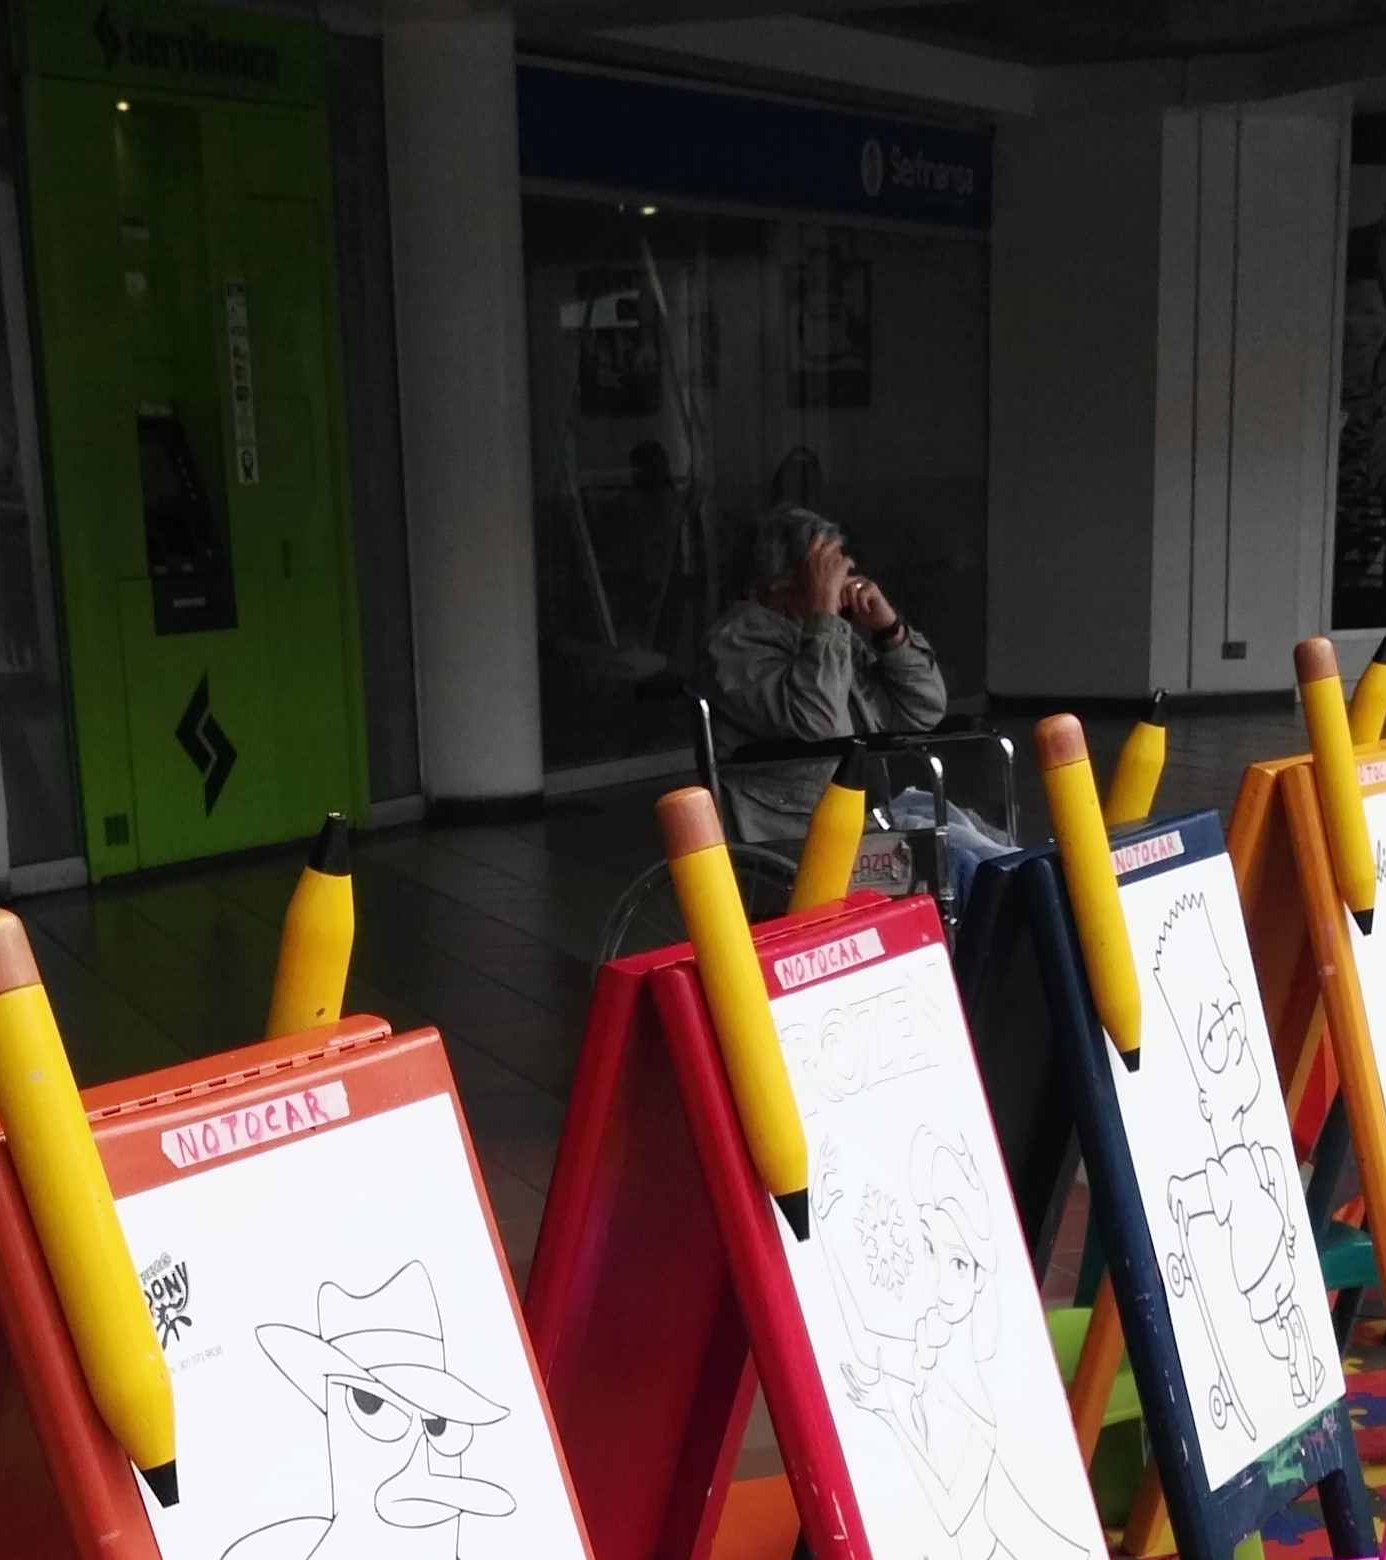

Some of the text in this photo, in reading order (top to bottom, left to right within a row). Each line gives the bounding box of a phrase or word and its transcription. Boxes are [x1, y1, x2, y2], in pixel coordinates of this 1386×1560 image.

[853, 853, 892, 874] AZA
[781, 938, 862, 987] NOTOCAR
[779, 962, 962, 1119] ROZEN
[176, 1090, 330, 1164] NOTOCAR
